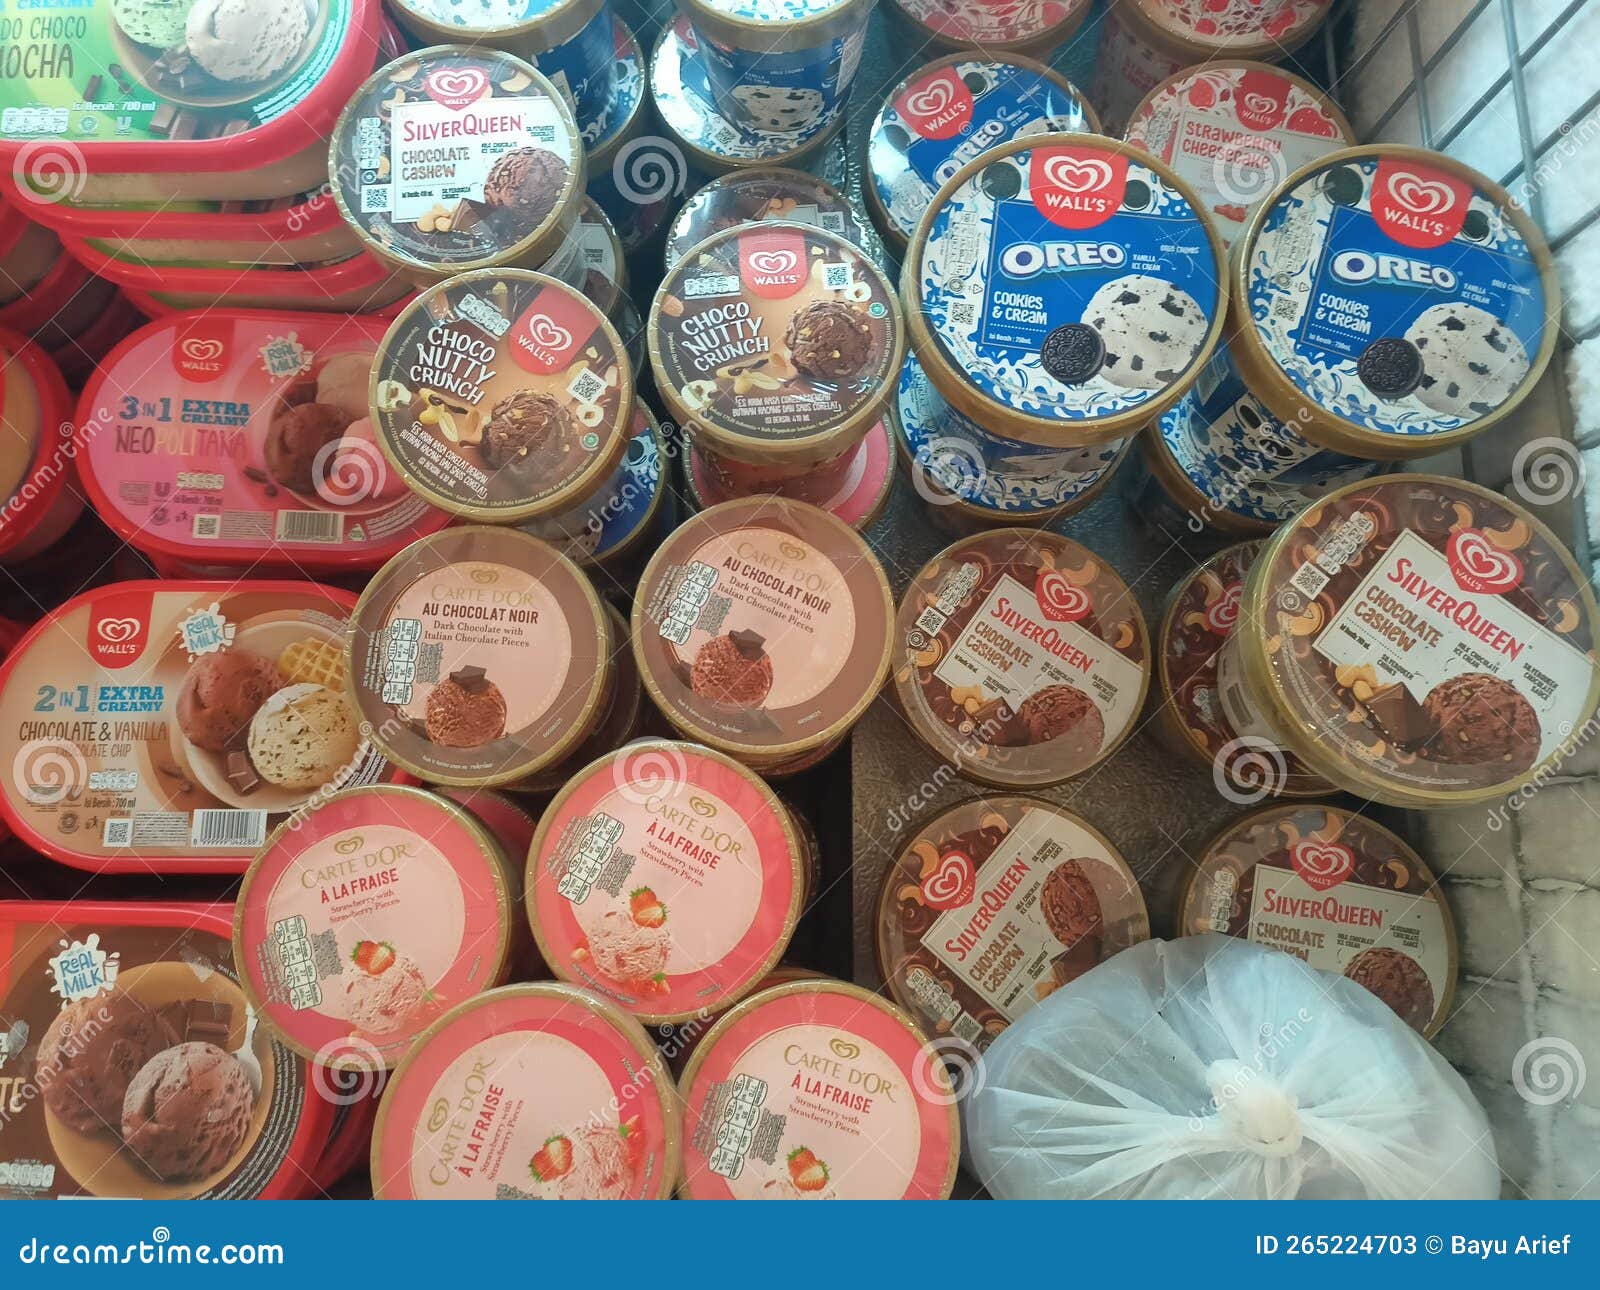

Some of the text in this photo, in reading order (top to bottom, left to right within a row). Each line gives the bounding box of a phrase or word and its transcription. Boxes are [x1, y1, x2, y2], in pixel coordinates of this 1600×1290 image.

[30, 16, 87, 39] CHOCO
[924, 102, 967, 132] WALL'S
[1241, 110, 1273, 125] WALL'S
[402, 147, 470, 165] CHOCOLATE
[935, 120, 1004, 185] OREO
[1044, 192, 1107, 212] WALL'S
[1384, 207, 1444, 236] WALL'S
[1002, 243, 1125, 277] OREO
[1132, 254, 1156, 263] VANILLA
[1333, 251, 1456, 289] OREO
[754, 275, 797, 285] WALL'S
[681, 302, 750, 335] CHOCO
[992, 307, 1003, 318] &
[1315, 309, 1326, 321] &
[427, 326, 495, 363] CHOCO
[518, 335, 556, 366] WALL'S
[681, 317, 763, 357] NUTTY
[182, 362, 220, 371] WALL'S
[417, 343, 496, 386] NUTTY
[694, 336, 769, 371] CRUNCH
[410, 365, 486, 405] CRUNCH
[120, 397, 171, 421] 3 IN 1
[182, 400, 249, 415] EXTRA
[182, 415, 249, 426] CREAMY
[116, 424, 245, 458] NEOPOLITANA
[737, 542, 831, 594] CARTE D'OR
[1454, 569, 1482, 591] WALL'S
[432, 584, 536, 607] CARTE D'OR
[722, 556, 832, 615] AU CHOCOLAT NOIR
[728, 576, 812, 621] Dark Chocolate with
[423, 603, 538, 624] AU CHOCOLAT NOIR
[717, 582, 814, 633] Italian Chocolate Pieces
[1366, 585, 1443, 648] CHOCOLATE
[424, 631, 530, 648] Italian Chocolate Pieces
[434, 620, 524, 636] Dark Chocolate with
[97, 644, 136, 654] WALL'S
[974, 621, 1033, 668] CHOCOLATE
[34, 685, 90, 712] 2 IN 1
[97, 702, 162, 712] CREAMY
[99, 686, 164, 700] EXTRA
[19, 721, 168, 742] CHOCOLATE & VANILLA
[111, 744, 131, 758] CHIP
[645, 795, 743, 864] CARTE D'OR
[646, 818, 720, 870] À LA FRAISE
[302, 843, 416, 888] CARTE D'OR
[639, 848, 704, 887] Strawberry Pieces
[648, 842, 705, 877] Strawberry with
[320, 868, 400, 904] À LA FRAISE
[969, 921, 1020, 982] CHOCOLATE
[1257, 922, 1325, 949] CHOCOLATE
[784, 1044, 896, 1104] CARTE D'OR
[791, 1070, 873, 1114] À LA FRAISE
[429, 1058, 496, 1186] CARTE D'OR
[463, 1145, 482, 1164] LA
[473, 1083, 504, 1146] FRAISE
[788, 1104, 860, 1137] Strawberry Pieces
[796, 1096, 860, 1126] Strawberry with
